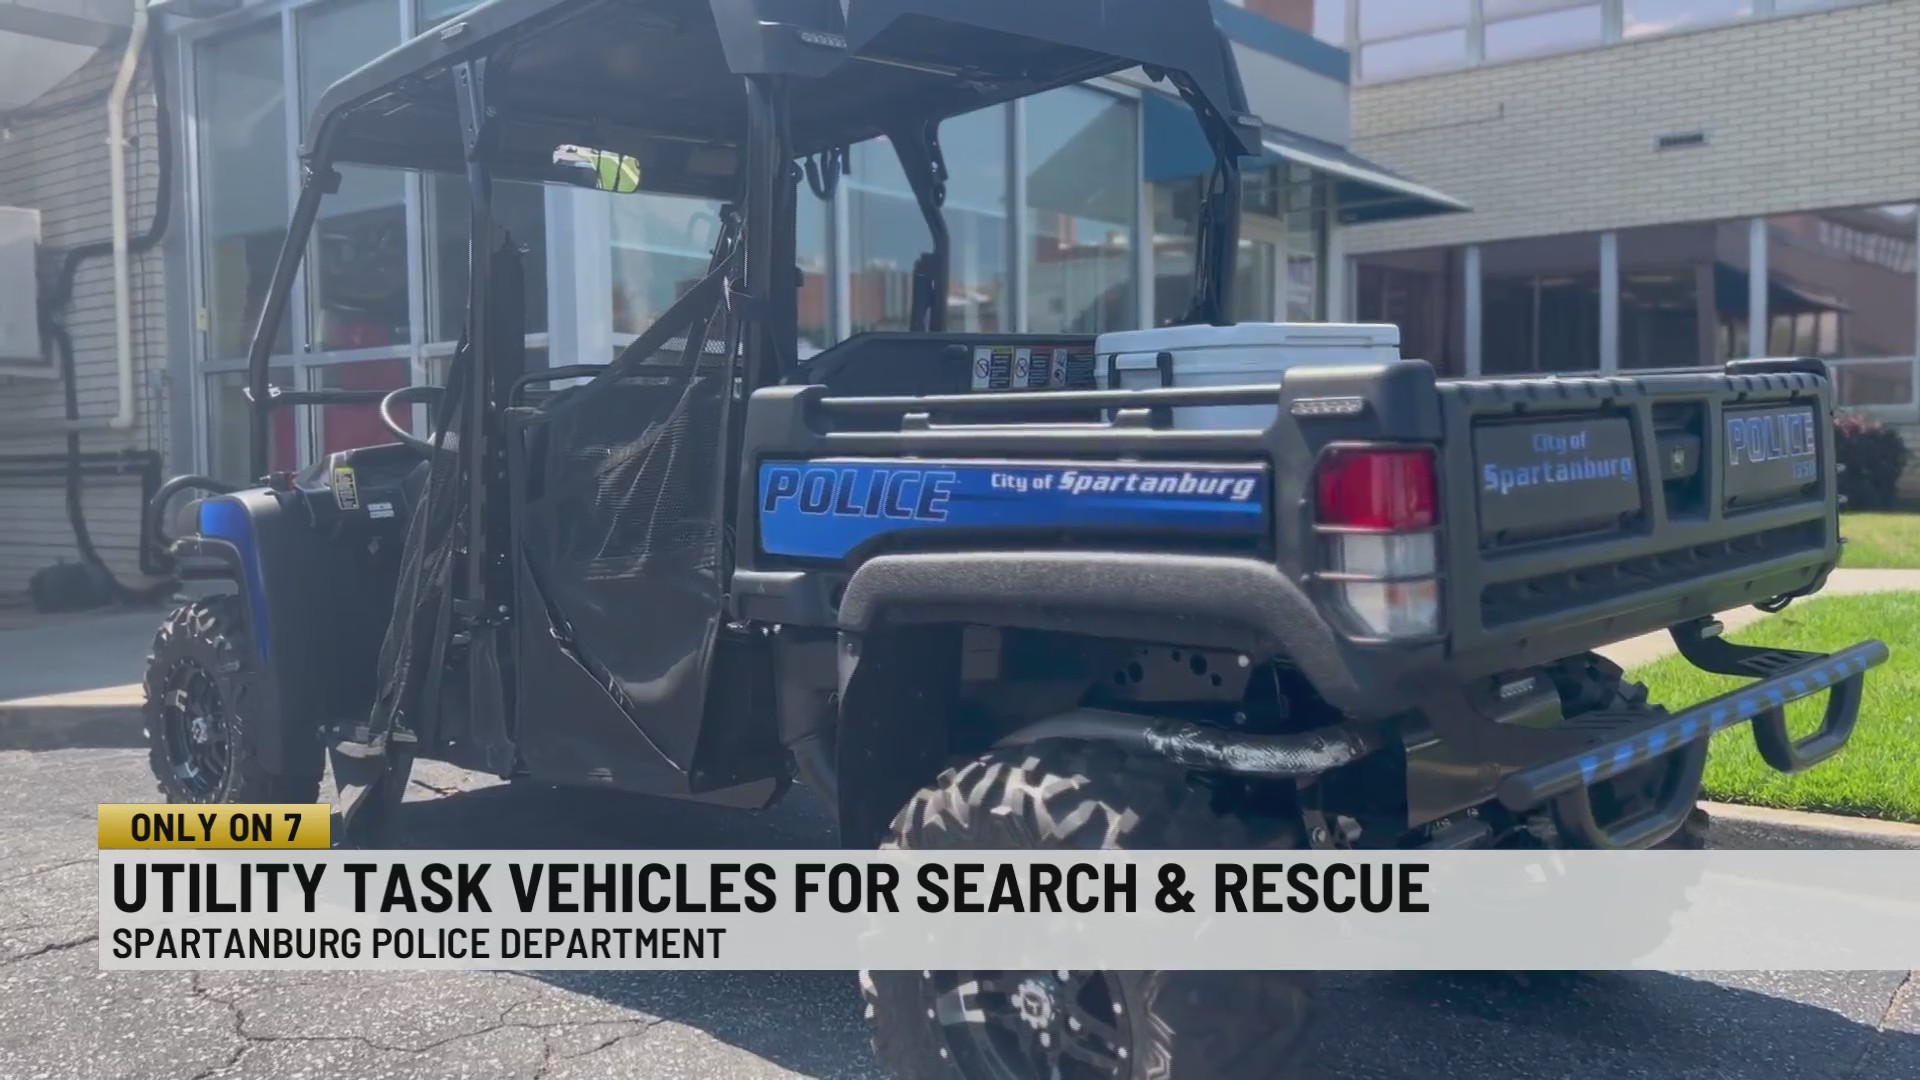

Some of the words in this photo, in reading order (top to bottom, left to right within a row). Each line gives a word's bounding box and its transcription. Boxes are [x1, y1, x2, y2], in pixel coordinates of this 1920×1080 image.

[1533, 433, 1568, 455] City
[1570, 430, 1587, 449] of
[1727, 411, 1815, 466] POLICE
[763, 468, 957, 521] POLICE
[990, 473, 1028, 492] City
[1032, 475, 1053, 490] of
[1057, 471, 1256, 500] Spartanburg
[1483, 456, 1633, 496] Spartanburg
